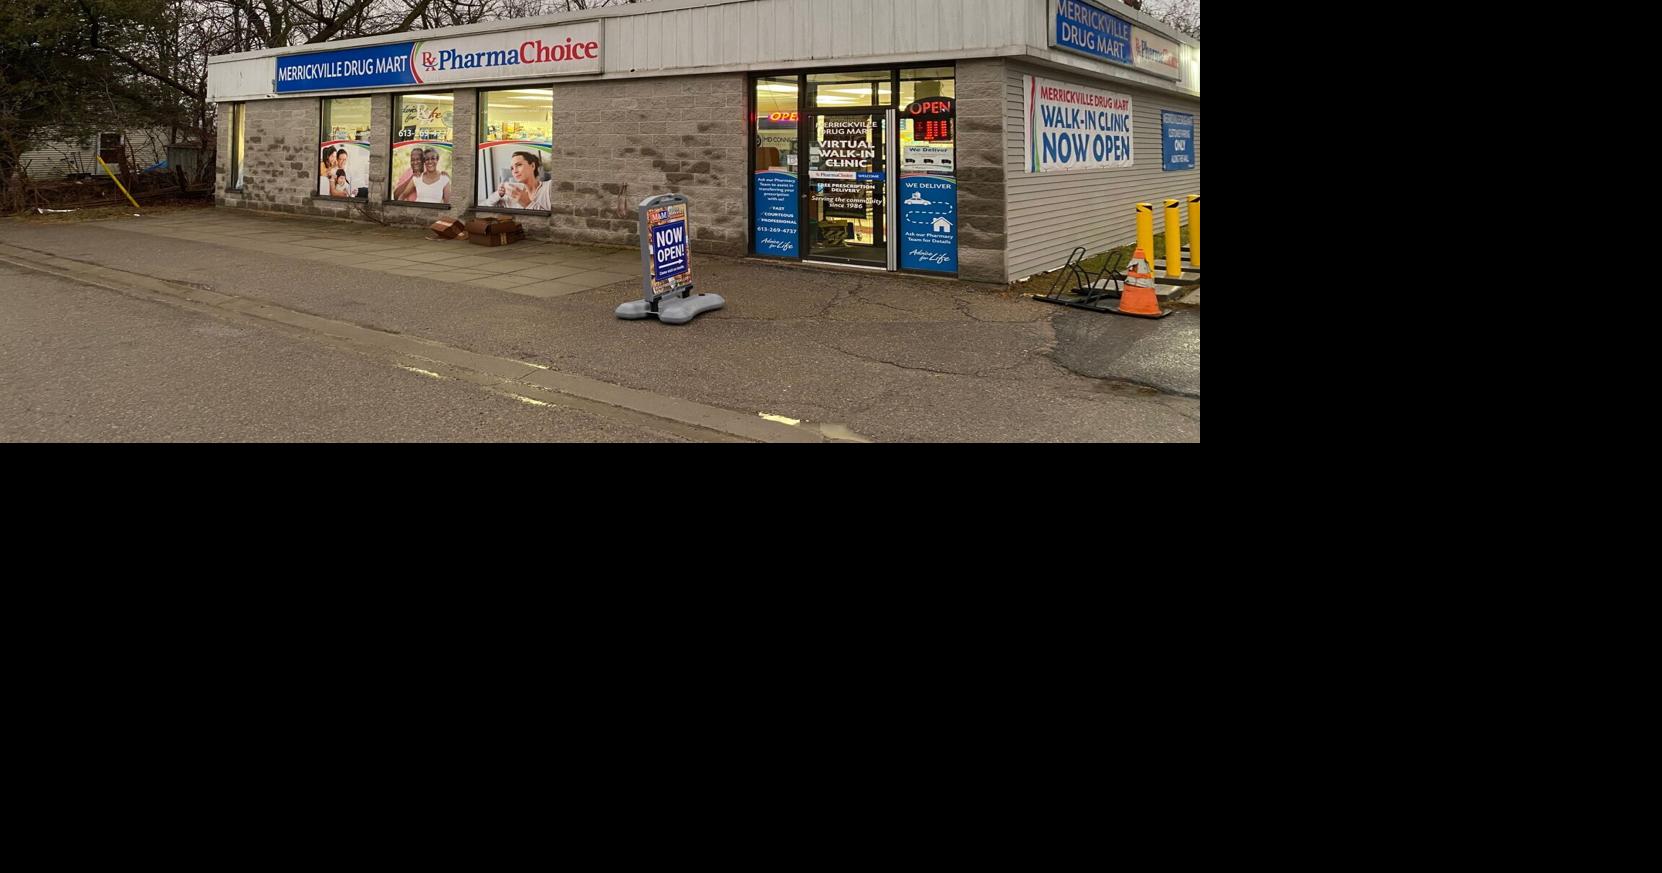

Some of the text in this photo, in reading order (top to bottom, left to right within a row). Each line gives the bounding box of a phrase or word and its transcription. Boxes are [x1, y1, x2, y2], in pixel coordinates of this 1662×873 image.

[1056, 0, 1129, 41] MERRICKVILLE
[1062, 22, 1125, 59] DRUG MART
[438, 37, 598, 70] PharmaChoice
[278, 55, 408, 82] MERRICKVILLE DRUG MART
[909, 101, 951, 115] OPEN
[1040, 86, 1129, 111] MERRICKVILLE DRUG MART
[770, 112, 798, 121] OPE
[1041, 104, 1129, 132] WALK-IN CLINIC
[818, 140, 875, 148] VIRTUAL
[818, 150, 875, 158] WALK-IN
[1042, 132, 1130, 163] NOW OPEN
[825, 159, 868, 168] CLINIC
[656, 226, 683, 248] NOW
[657, 244, 685, 263] OPEN!
[928, 252, 951, 264] Life
